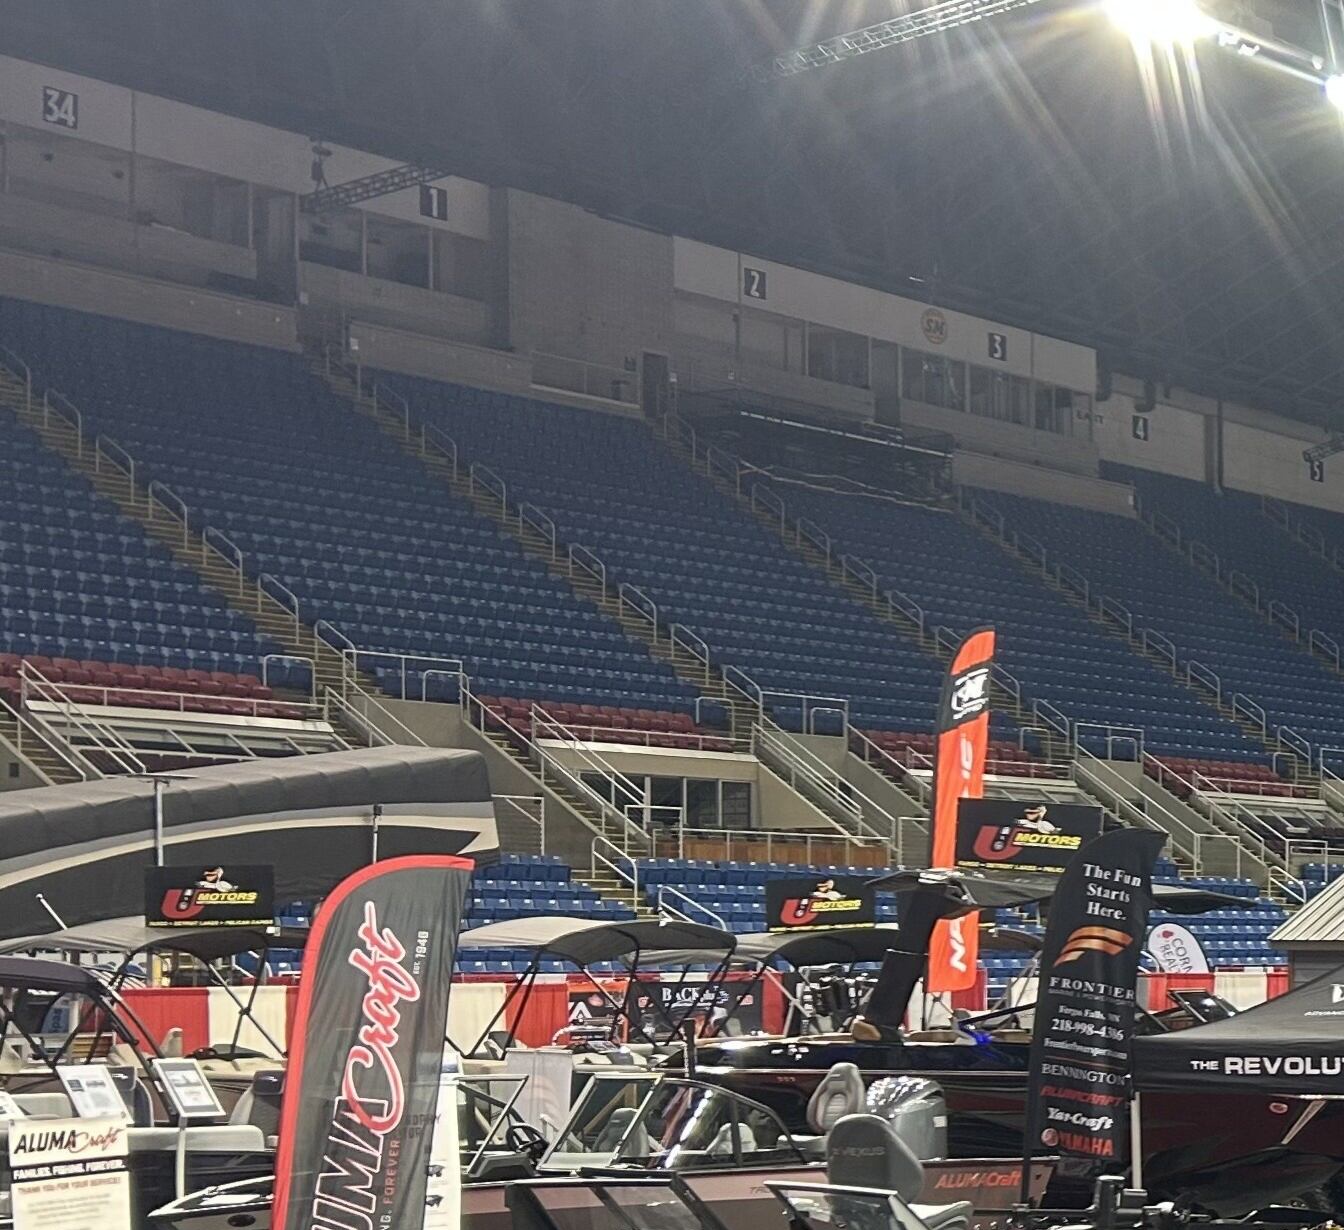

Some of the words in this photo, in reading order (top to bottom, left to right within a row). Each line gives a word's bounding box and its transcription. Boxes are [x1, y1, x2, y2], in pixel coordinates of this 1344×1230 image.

[43, 89, 77, 127] 34
[1014, 831, 1082, 849] MOTORS
[1083, 863, 1112, 882] The
[1114, 868, 1142, 888] Fun
[197, 892, 258, 902] MOTORS
[1086, 883, 1131, 904] Starts
[1086, 901, 1127, 921] Here.
[1049, 976, 1135, 1000] FRONTIER
[1041, 1063, 1125, 1086] BENNINGTON
[1190, 1060, 1219, 1070] THE
[13, 1126, 125, 1154] ALUMACraft
[1057, 1131, 1115, 1157] YAMAHA
[382, 1138, 401, 1207] FOREVER
